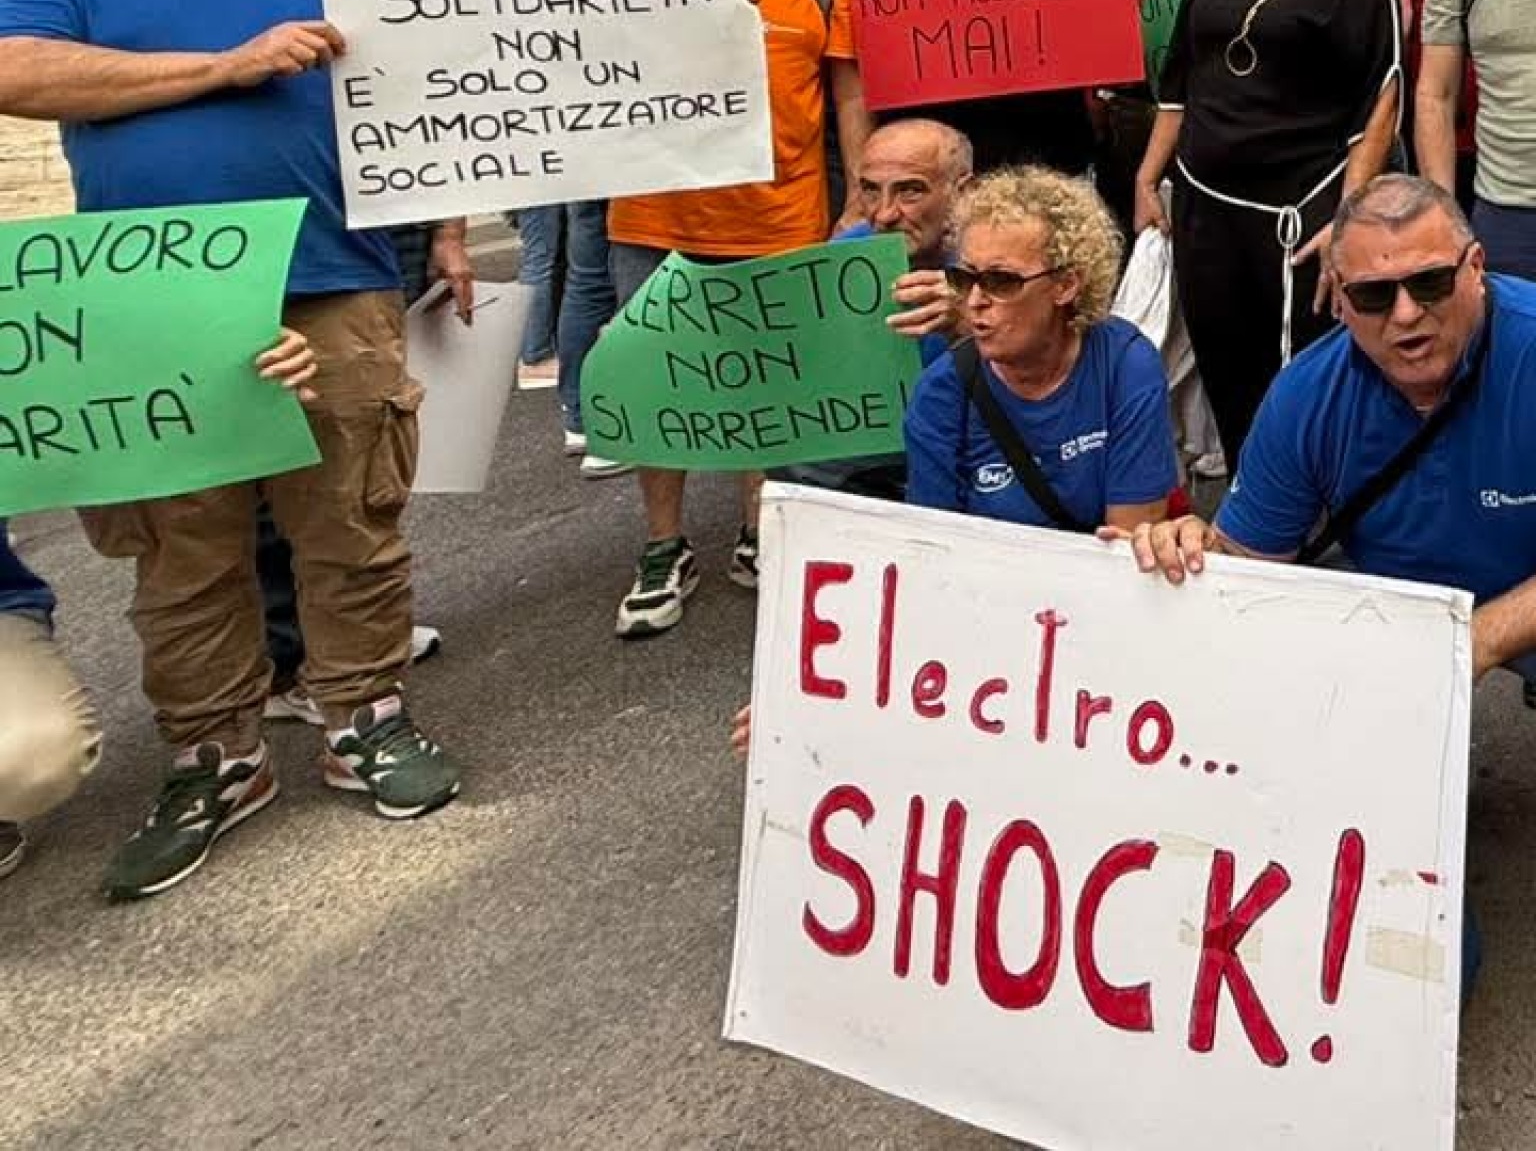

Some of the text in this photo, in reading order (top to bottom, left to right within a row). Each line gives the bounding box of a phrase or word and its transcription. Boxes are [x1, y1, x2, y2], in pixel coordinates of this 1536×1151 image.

[491, 28, 584, 62] NON
[425, 67, 549, 100] SOLO
[583, 60, 641, 87] UN
[350, 90, 749, 155] AMMORTIZZATORE
[357, 149, 565, 196] SOCIALE
[0, 220, 248, 290] AVORO
[664, 340, 802, 393] NON
[590, 394, 635, 444] SI
[803, 783, 1365, 1067] SHOCK!
